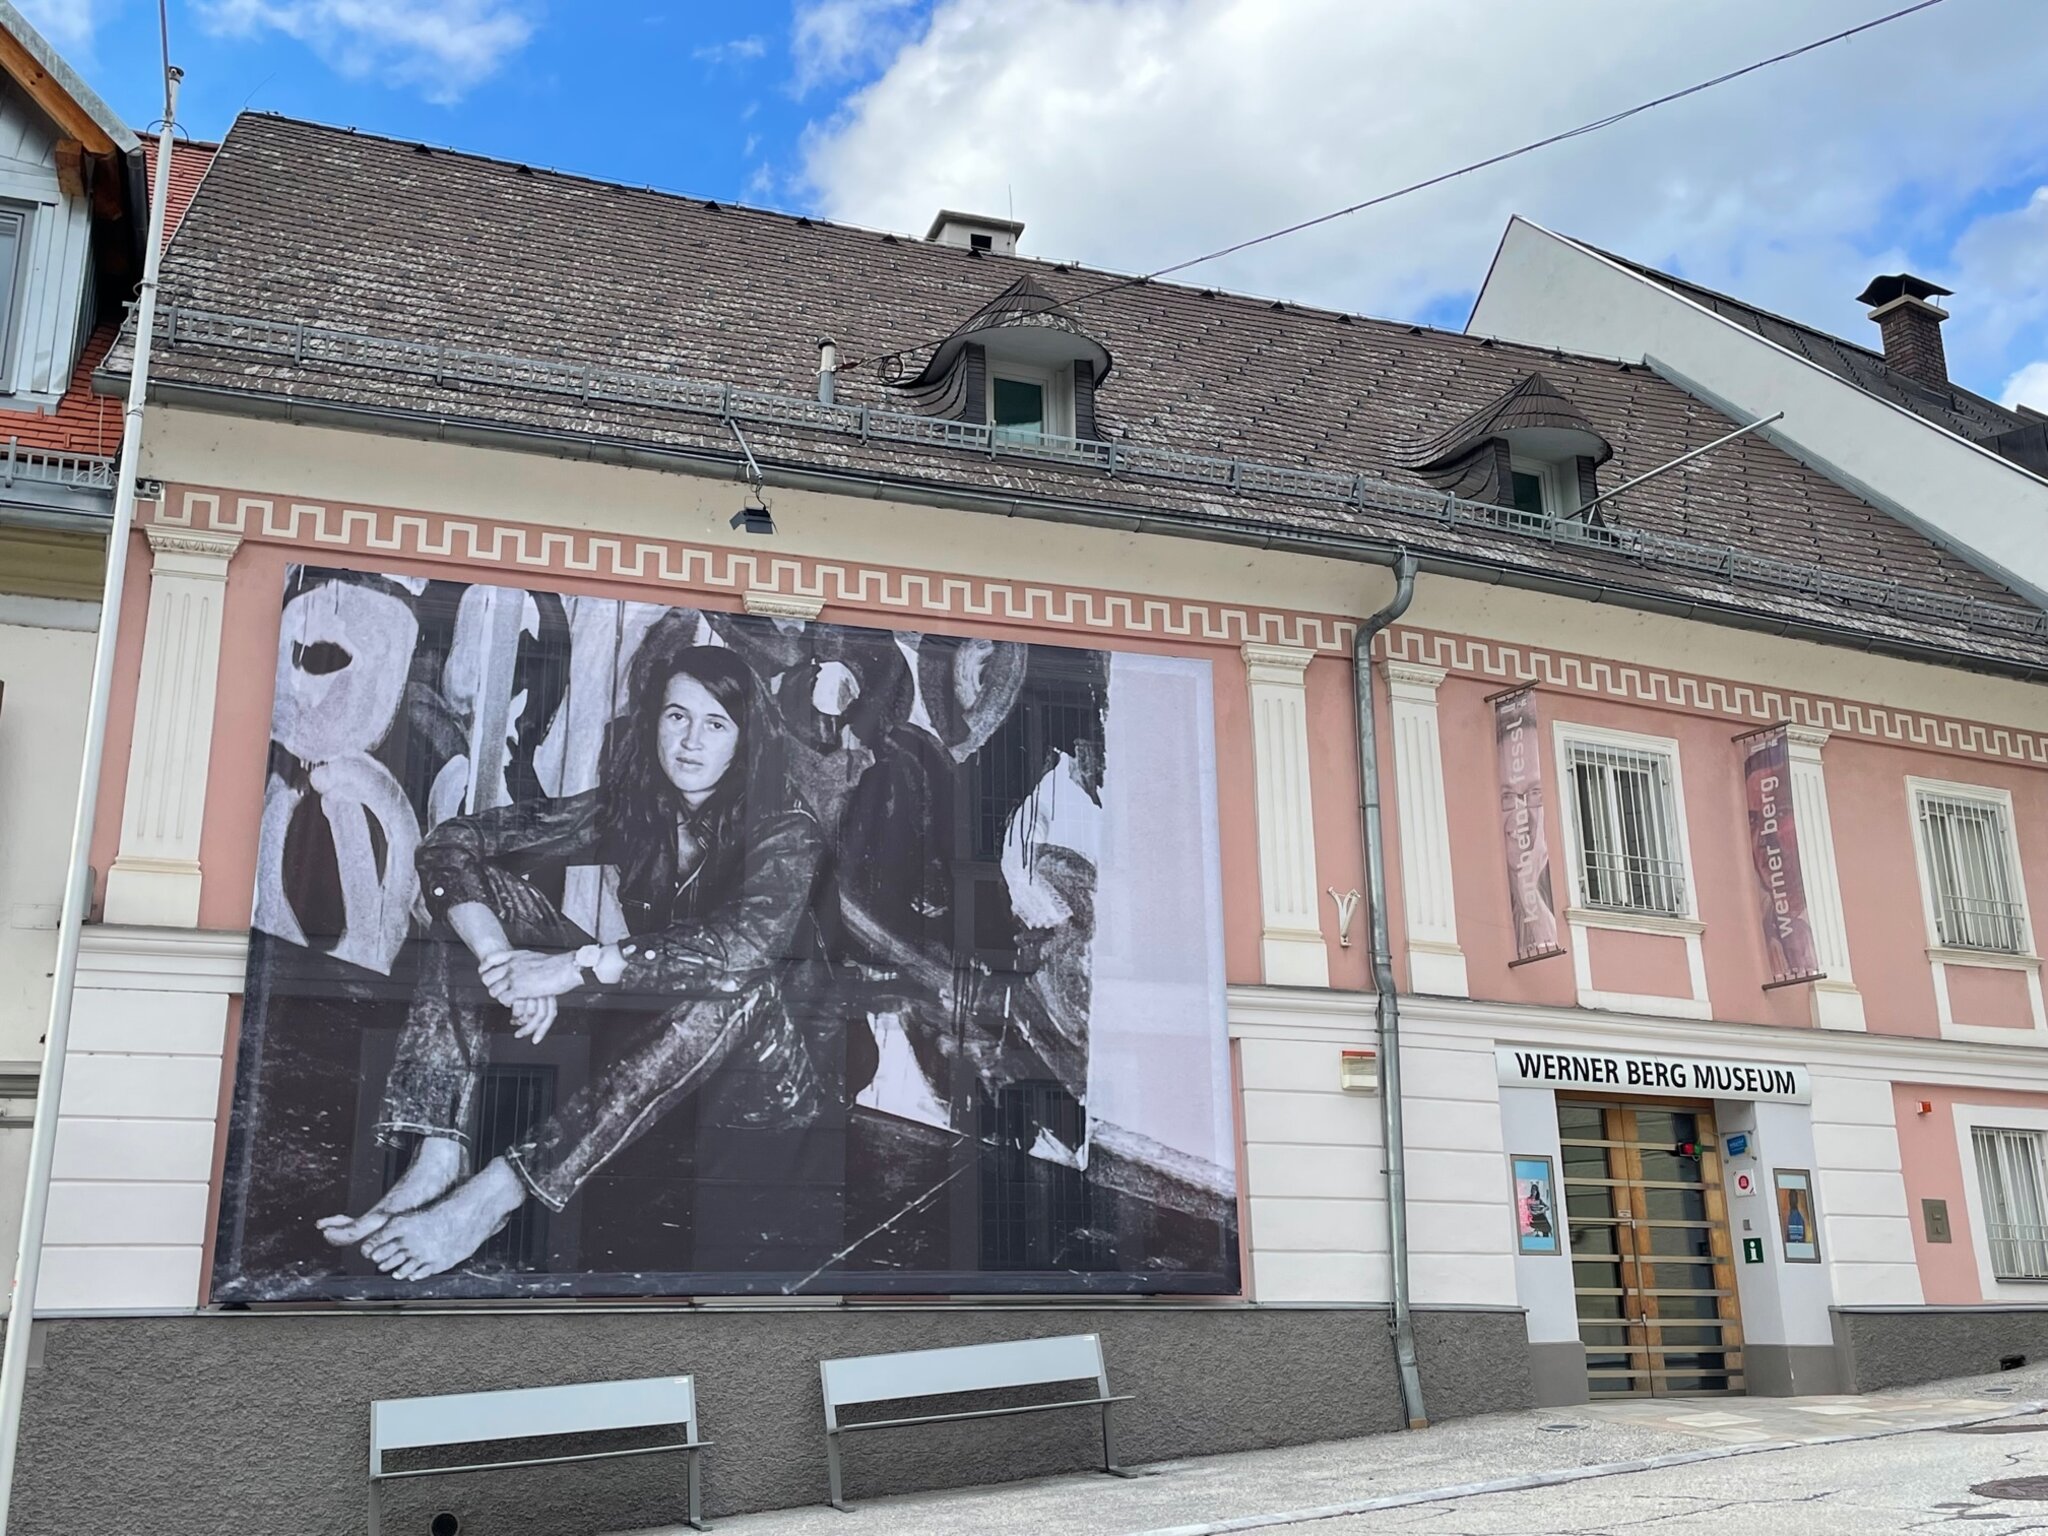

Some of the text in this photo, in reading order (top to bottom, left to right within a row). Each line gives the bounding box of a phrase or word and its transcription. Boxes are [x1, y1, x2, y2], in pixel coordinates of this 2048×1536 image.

[1506, 716, 1526, 785] fessl
[1760, 775, 1779, 836] berg
[1766, 845, 1793, 938] werner
[1515, 1052, 1796, 1095] WERNER BERG MUSEUM
